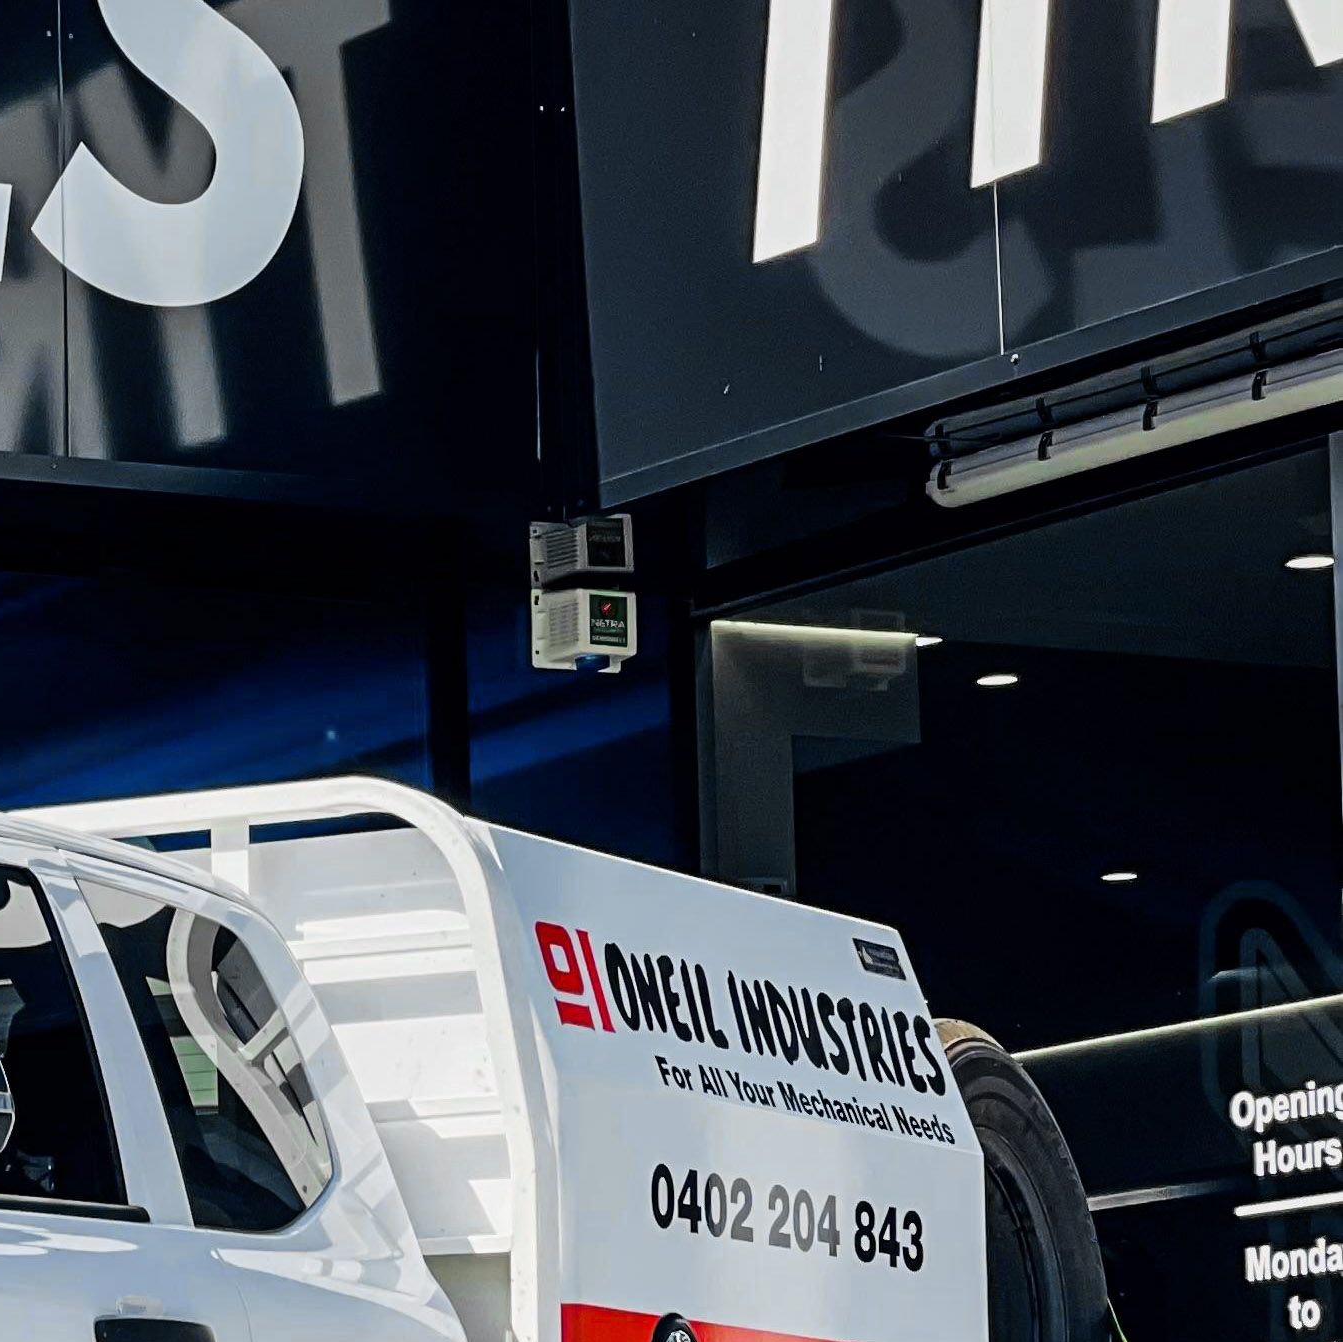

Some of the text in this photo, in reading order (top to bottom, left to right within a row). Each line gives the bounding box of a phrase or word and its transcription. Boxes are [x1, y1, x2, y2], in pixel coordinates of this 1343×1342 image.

[605, 942, 946, 1096] ONEIL INDUSTRIES
[655, 1056, 955, 1146] For All Your Mechanical Needs
[1253, 1137, 1342, 1177] Hours
[651, 1163, 924, 1272] 0402 204 843
[1244, 1236, 1343, 1282] Monda
[1287, 1295, 1321, 1330] to
